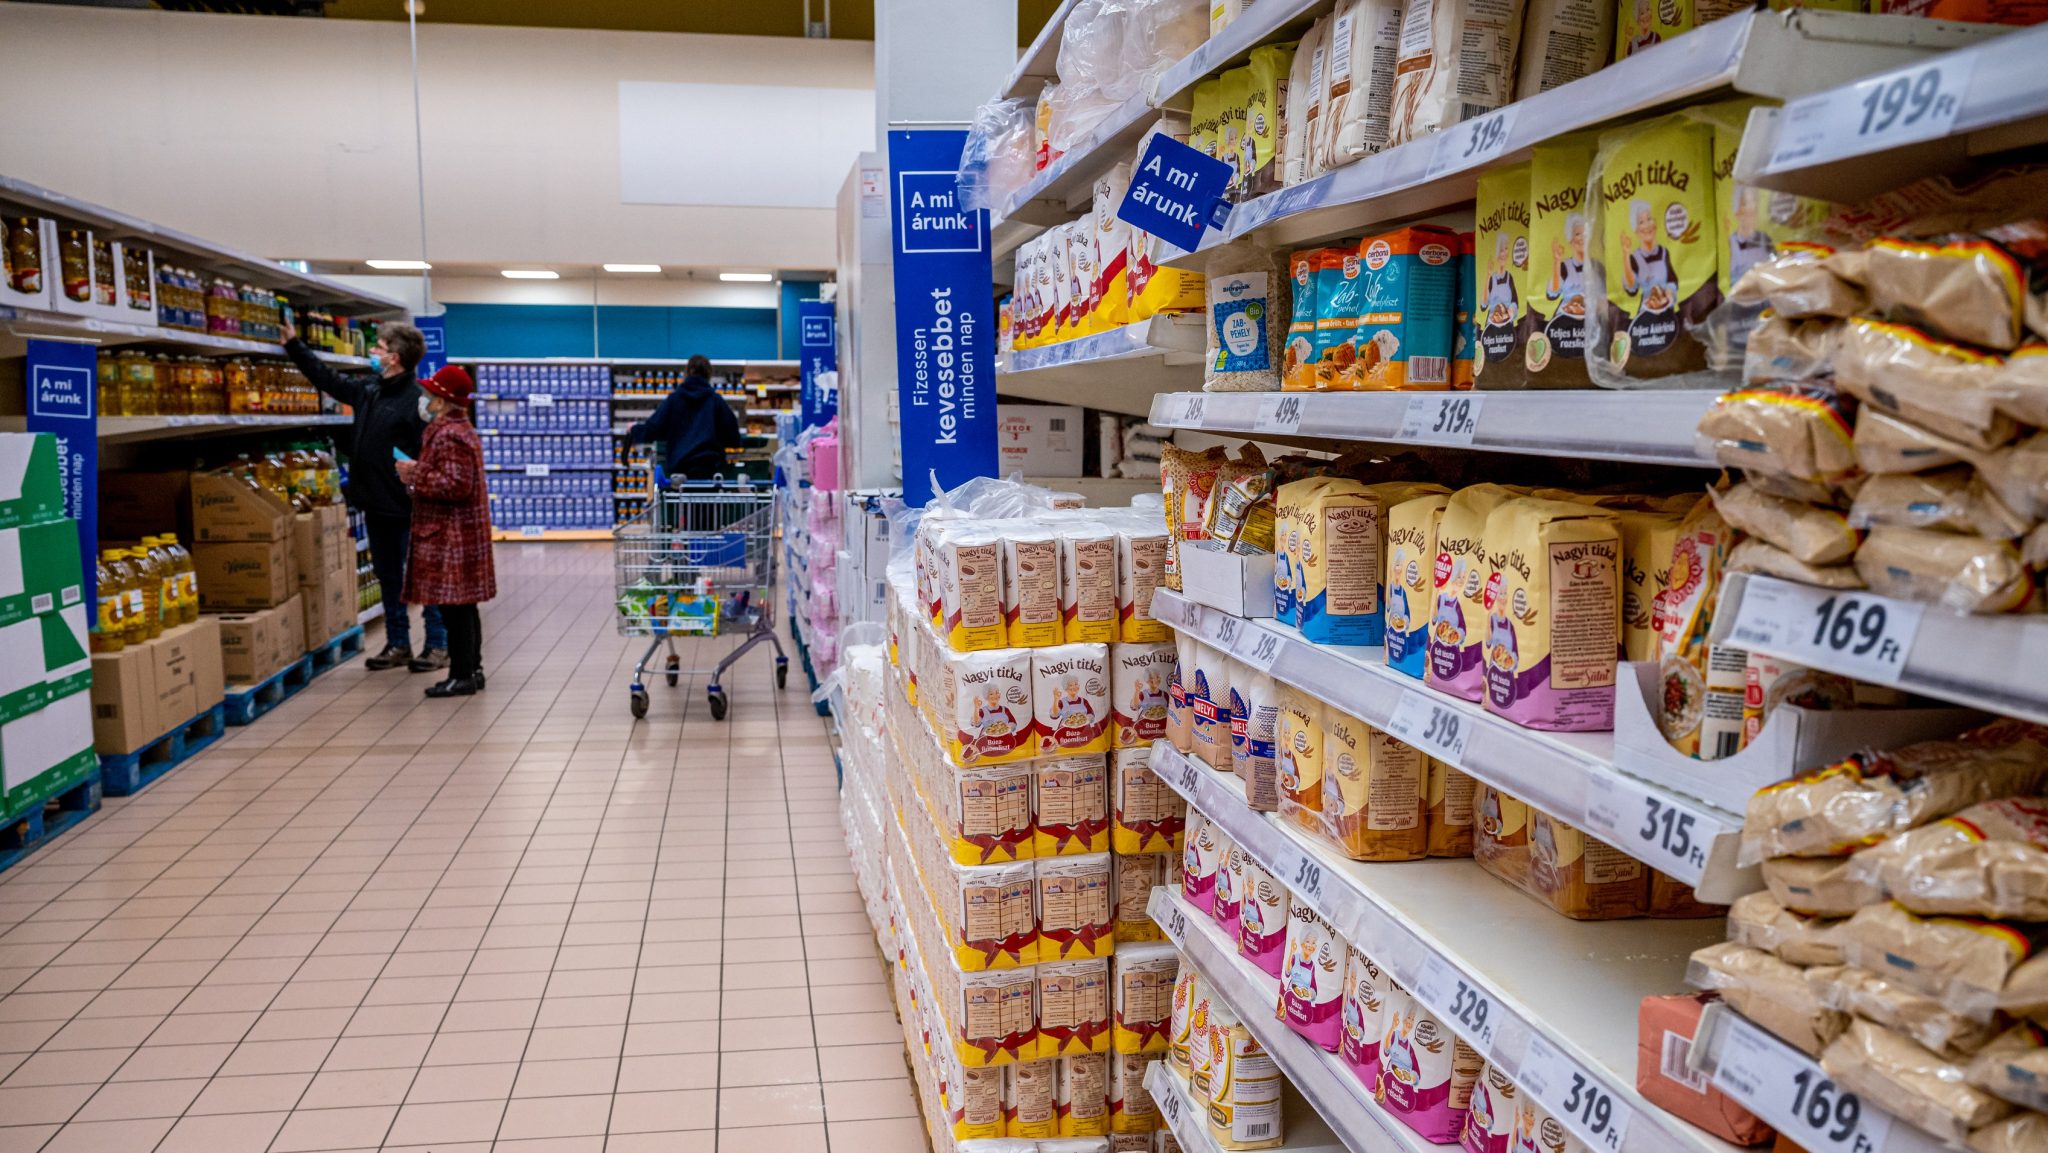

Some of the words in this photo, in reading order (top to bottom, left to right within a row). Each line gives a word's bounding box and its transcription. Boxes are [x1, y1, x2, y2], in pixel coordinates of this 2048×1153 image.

[1858, 68, 1942, 136] 199
[1931, 93, 1954, 118] Ft
[1369, 142, 1381, 153] kg
[1463, 114, 1504, 158] 319
[1144, 154, 1162, 177] A
[1166, 167, 1199, 192] mi
[1646, 160, 1689, 192] titka
[1714, 148, 1738, 182] Nag
[910, 191, 925, 208] A
[930, 191, 953, 208] mi
[1479, 205, 1506, 239] Nagyi
[1368, 250, 1389, 258] cerbona
[1249, 307, 1260, 315] Bio
[962, 311, 977, 351] nap
[1560, 339, 1585, 348] rozslis
[913, 328, 928, 406] Fizessen
[931, 286, 958, 446] kevesebbet
[41, 378, 51, 389] A
[54, 379, 72, 390] mi
[959, 356, 976, 419] minden
[1275, 398, 1299, 424] 499
[1433, 399, 1471, 433] 319
[1464, 421, 1474, 435] Ft
[73, 453, 84, 477] nap
[73, 479, 82, 519] minden
[1328, 508, 1355, 523] Nagyi
[1357, 508, 1377, 522] titka
[959, 548, 979, 559] Nagyi
[1018, 545, 1039, 555] Nagyi
[1077, 543, 1098, 554] Nagyi
[1133, 542, 1153, 553] Nagyi
[1154, 541, 1168, 551] titk
[1553, 544, 1589, 566] Nagyi
[1591, 544, 1617, 561] titka
[1813, 596, 1888, 656] 169
[1878, 638, 1900, 664] Ft
[1122, 652, 1156, 670] Nagyi
[1158, 652, 1178, 664] titk
[1251, 633, 1277, 660] 319
[962, 667, 994, 686] Nagyi
[997, 667, 1023, 681] titka
[1040, 658, 1074, 678] Nagyi
[1076, 659, 1102, 674] titka
[1423, 706, 1459, 748] 319
[1180, 765, 1198, 793] 369
[1640, 797, 1696, 857] 315
[1689, 851, 1705, 870] Ft
[1295, 857, 1321, 893] 319
[1169, 908, 1185, 938] 319
[1449, 980, 1489, 1033] 329
[1482, 1026, 1494, 1044] Ft
[1163, 1087, 1179, 1120] 249
[1564, 1071, 1613, 1134] 319
[1607, 1128, 1620, 1149] Ft
[1793, 1068, 1861, 1142] 169
[1852, 1133, 1873, 1153] Ft
